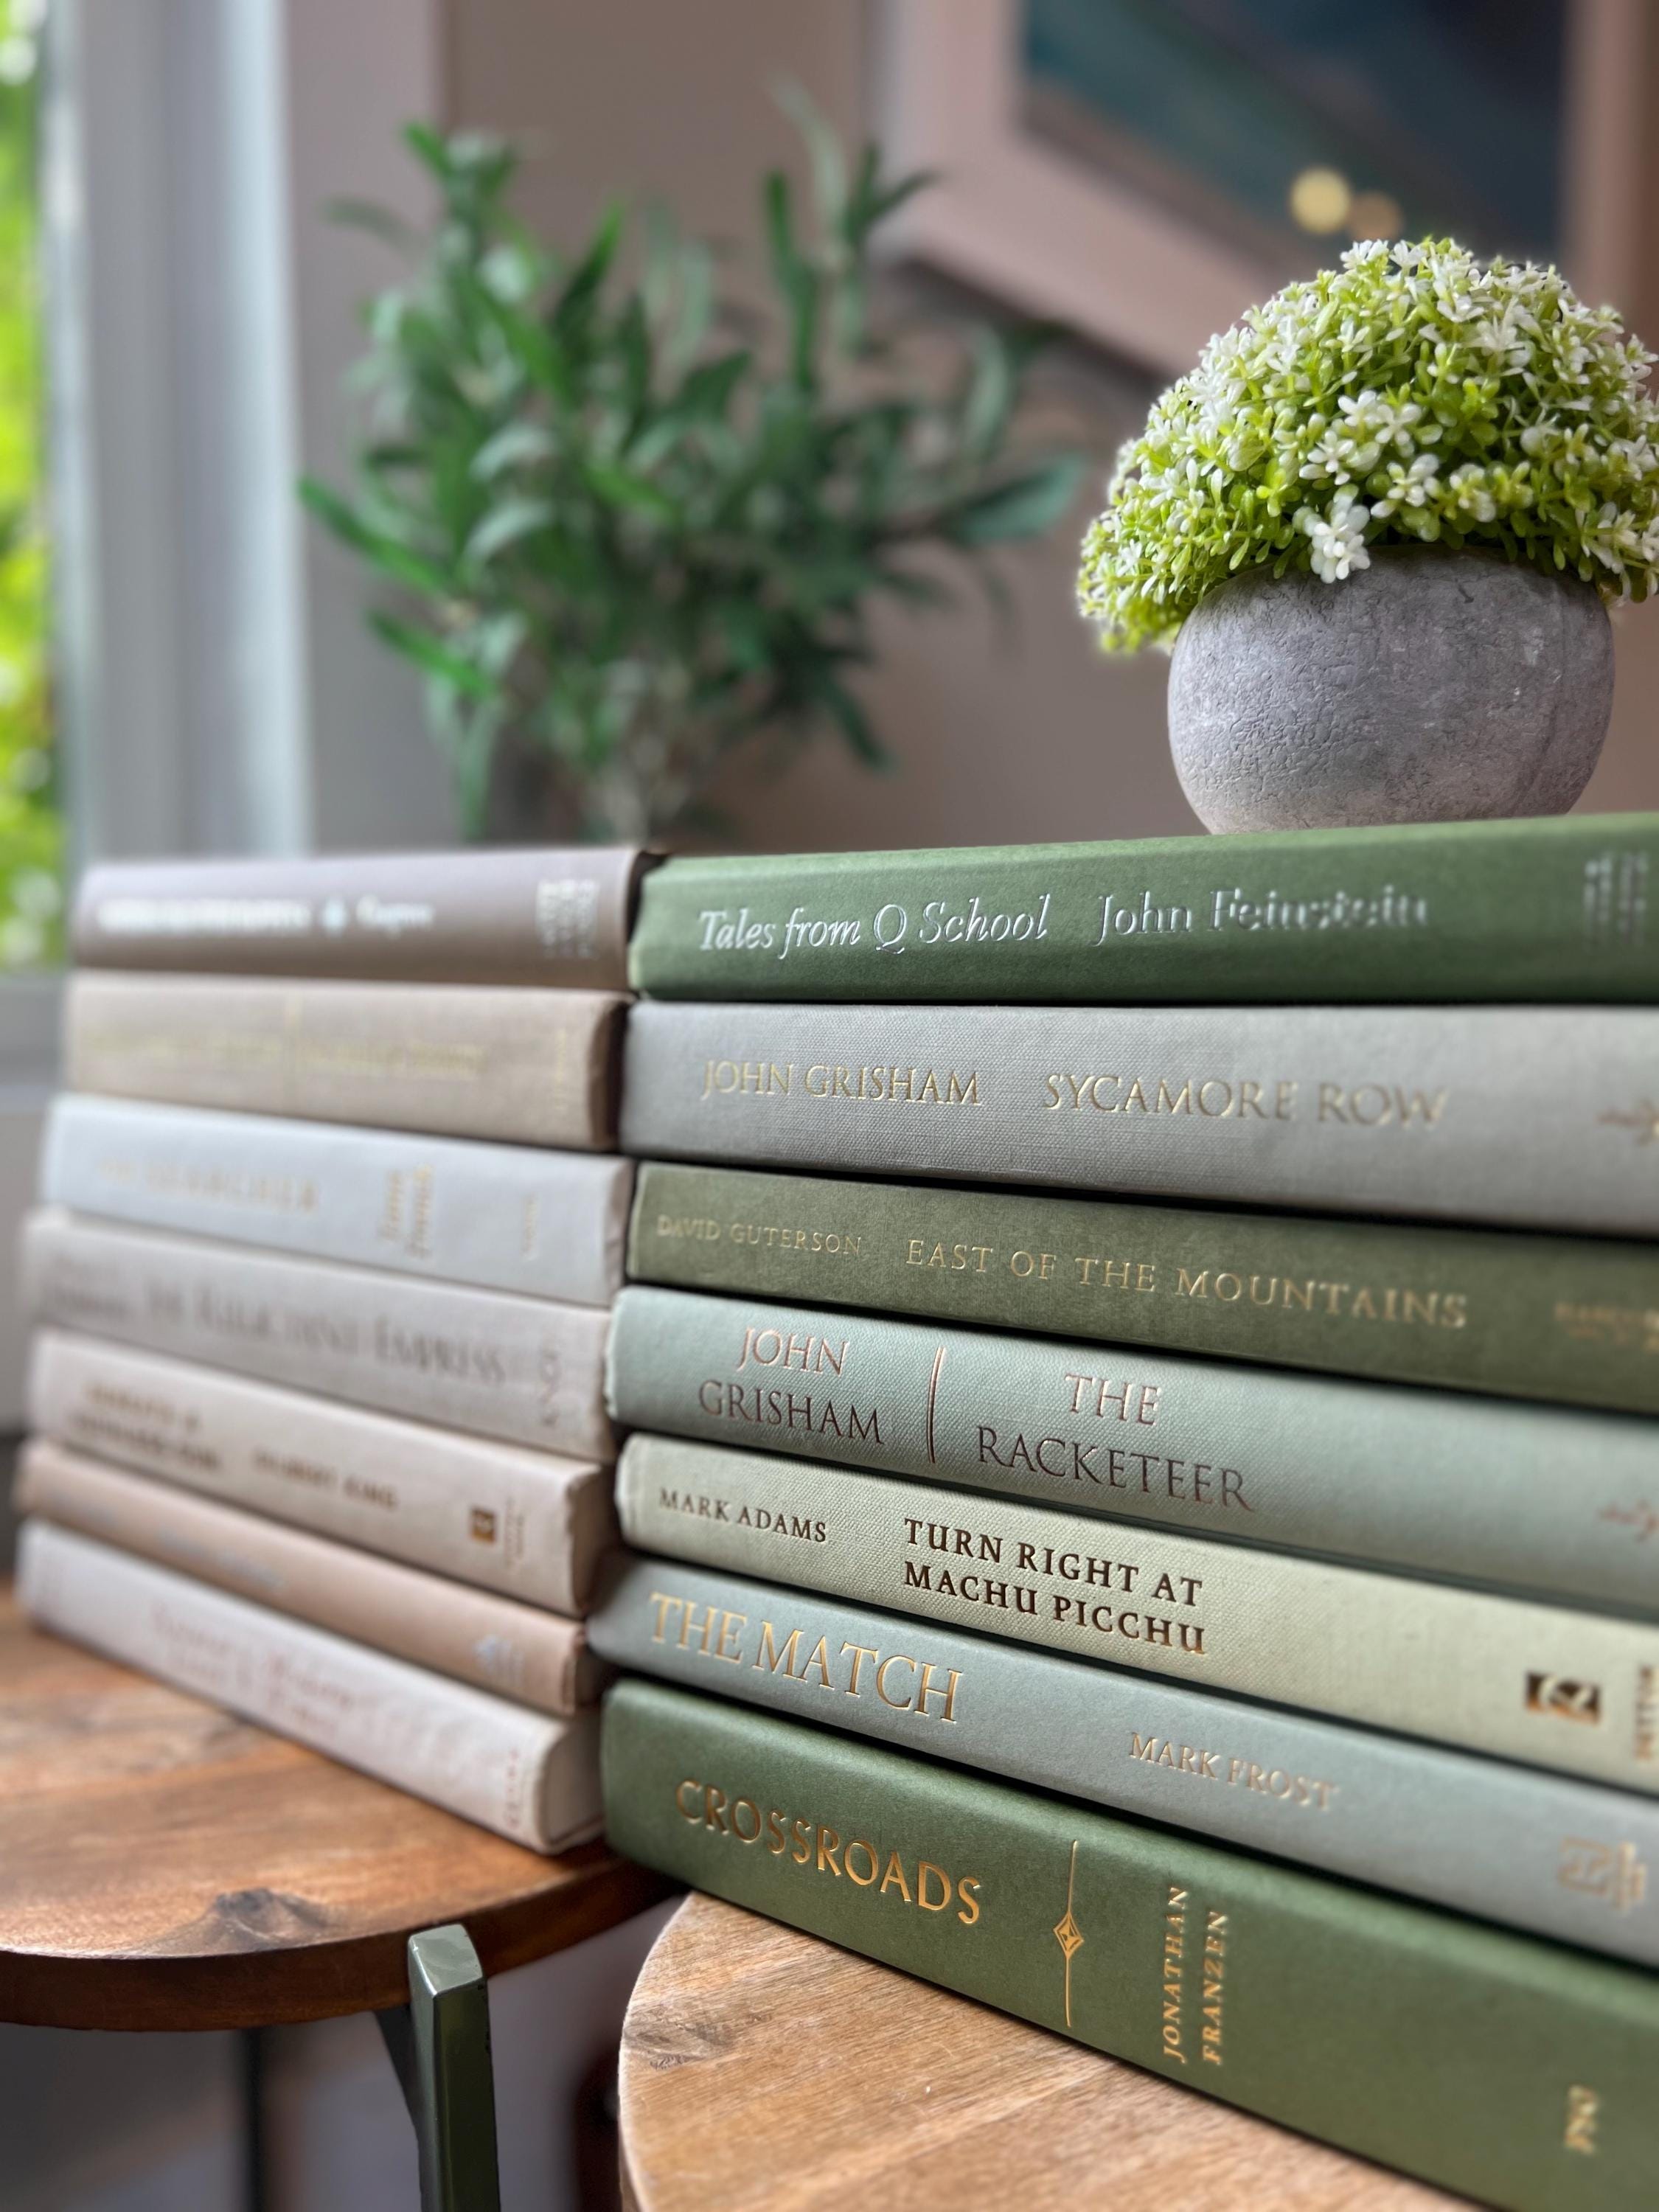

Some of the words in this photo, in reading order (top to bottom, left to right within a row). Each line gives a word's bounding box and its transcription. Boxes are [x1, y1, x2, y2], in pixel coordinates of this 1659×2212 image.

[698, 908, 776, 951] Tales
[778, 908, 860, 959] from
[873, 903, 907, 954] Q
[918, 894, 1051, 945] School
[1092, 890, 1192, 947] John
[701, 1060, 793, 1100] JOHN
[804, 1064, 981, 1106] GRISHAM
[1043, 1074, 1298, 1120] SYCAMORE
[1317, 1081, 1450, 1129] ROW
[657, 1215, 721, 1241] DAVID
[731, 1223, 861, 1256] GUTERSON
[906, 1239, 993, 1273] EAST
[1010, 1251, 1056, 1281] OF
[1075, 1257, 1157, 1293] THE
[1175, 1268, 1467, 1327] MOUNTAINS
[737, 1326, 849, 1377] JOHN
[698, 1380, 884, 1444] GRISHAM
[1065, 1373, 1163, 1426] THE
[975, 1425, 1254, 1512] RACKETEER
[660, 1488, 728, 1522] MARK
[737, 1506, 827, 1543] ADAMS
[903, 1517, 1003, 1565] TURN
[1018, 1542, 1140, 1594] RIGHT
[1154, 1572, 1204, 1608] AT
[904, 1561, 1038, 1617] MACHU
[1052, 1593, 1206, 1656] PICCHU
[650, 1592, 748, 1666] THE
[752, 1621, 964, 1725] MATCH
[1129, 1731, 1220, 1781] MARK
[1226, 1758, 1341, 1812] FROST
[675, 1778, 982, 1926] CROSSROADS
[1163, 1886, 1190, 2065] JONATHAN
[1202, 1910, 1230, 2067] FRANZEN
